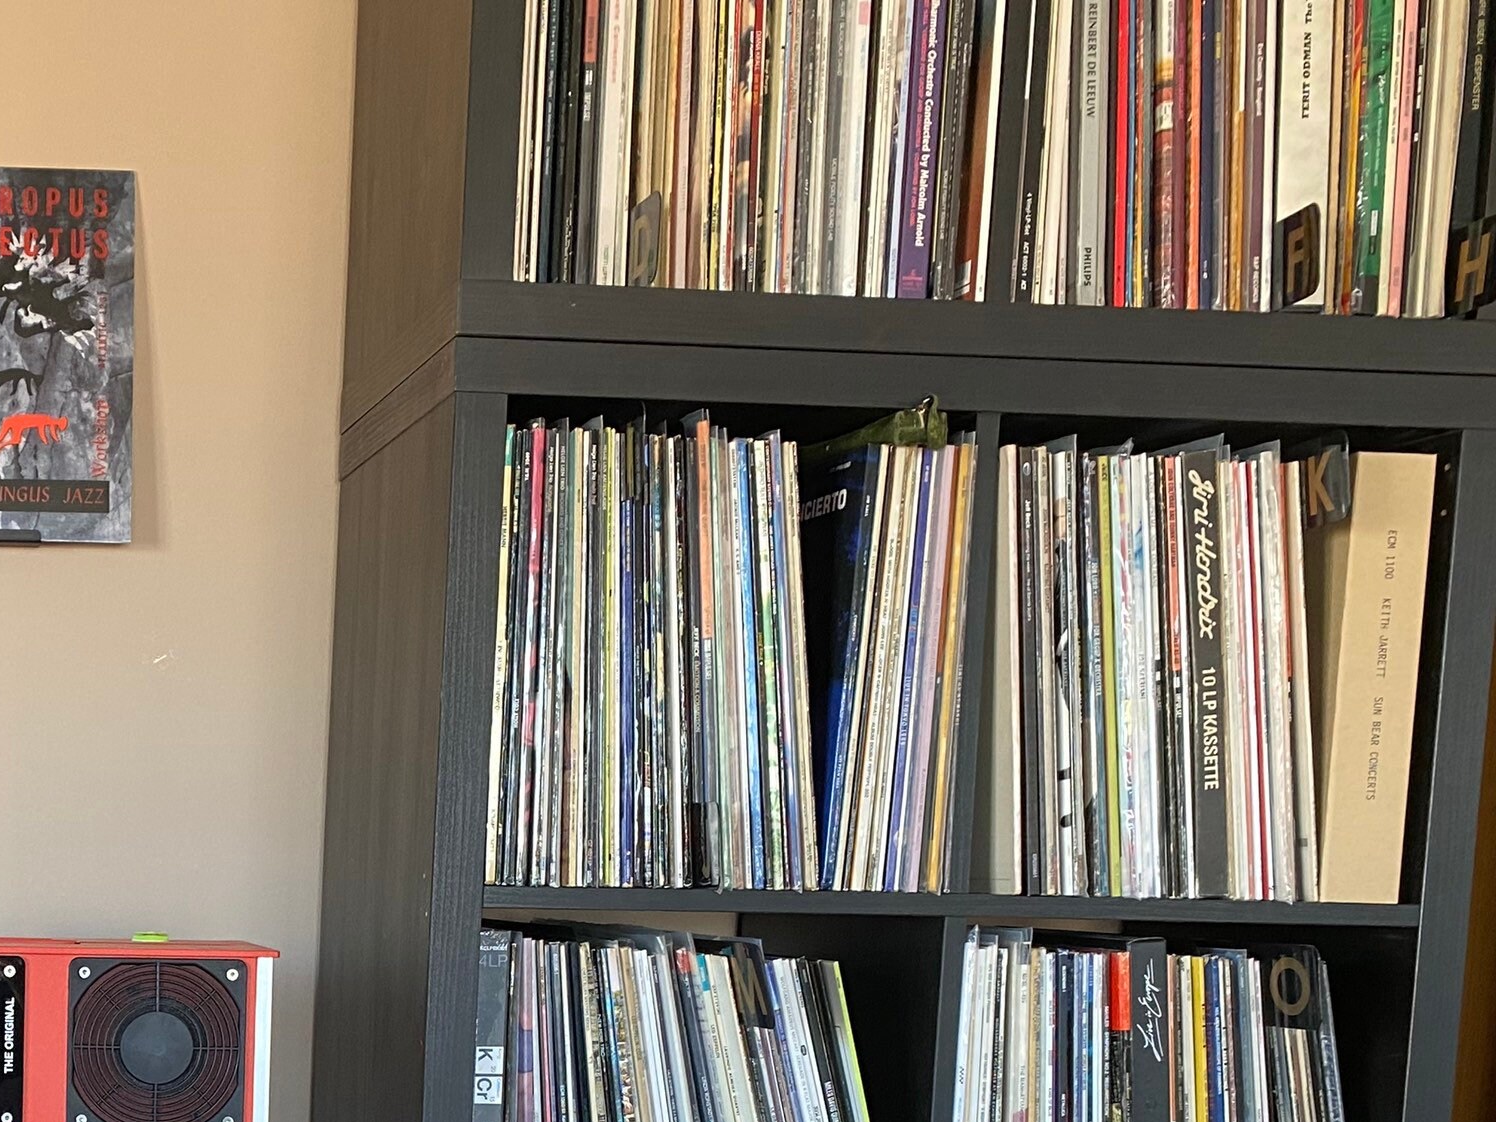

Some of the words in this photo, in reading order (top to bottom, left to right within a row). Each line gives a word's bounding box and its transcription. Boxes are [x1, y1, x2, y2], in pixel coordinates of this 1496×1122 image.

[1304, 2, 1313, 24] The
[754, 30, 762, 51] DIANA
[1087, 3, 1098, 57] REINBERT
[754, 52, 762, 71] KRALL
[1087, 61, 1097, 76] DE
[1302, 32, 1312, 79] ODMAN
[923, 50, 939, 97] Orchestra
[1086, 79, 1097, 118] LEEUW
[920, 98, 935, 152] Conducted
[919, 153, 931, 168] by
[916, 169, 930, 210] Malcolm
[914, 212, 926, 247] Arnold
[1083, 247, 1092, 287] PHILIPS
[1455, 233, 1491, 303] H
[91, 394, 109, 478] Workshop
[63, 487, 105, 504] JAZZ
[1307, 450, 1337, 517] K
[1188, 470, 1215, 531] Jimi
[1387, 529, 1396, 551] ECM
[1385, 555, 1394, 580] 1100
[1196, 527, 1218, 640] Hendrix
[1381, 597, 1391, 628] KEITH
[1375, 634, 1388, 679] JARRETT
[1202, 666, 1217, 687] 10
[1203, 691, 1218, 711] LP
[1373, 696, 1383, 716] SUN
[1371, 720, 1381, 746] BEAR
[1203, 715, 1219, 790] KASSETTE
[1365, 751, 1379, 801] CONCERTS
[479, 953, 508, 968] 4LP
[4, 997, 15, 1050] ORIGINAL
[4, 1052, 13, 1074] THE
[478, 1049, 493, 1061] K
[477, 1077, 493, 1099] Cr
[824, 1081, 833, 1096] MILES
[827, 1097, 836, 1112] DAVIS
